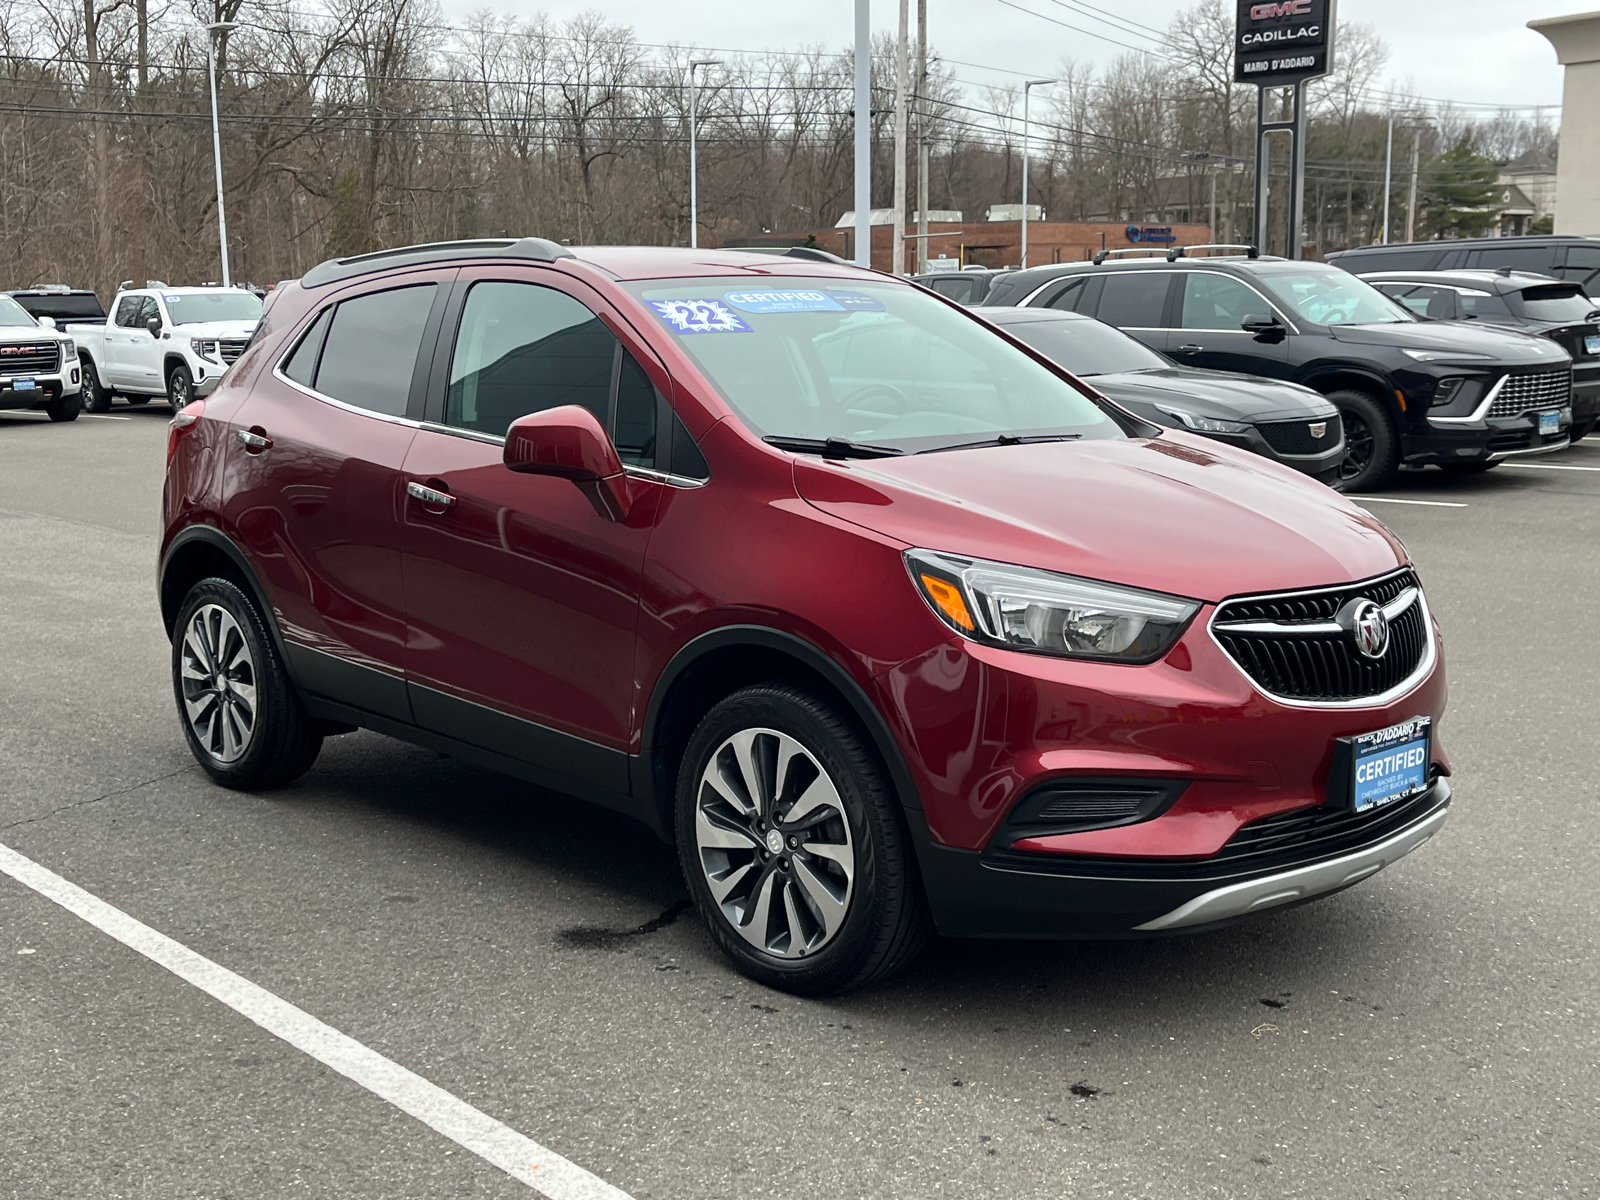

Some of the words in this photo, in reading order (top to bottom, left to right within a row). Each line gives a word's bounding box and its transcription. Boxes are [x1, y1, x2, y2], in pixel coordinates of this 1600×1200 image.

[1250, 0, 1311, 19] GMC
[1241, 26, 1319, 44] CADILLAC
[1243, 60, 1269, 73] MARIO
[1271, 56, 1315, 70] D'ADDARIO
[728, 292, 825, 303] CERTIFIED
[675, 305, 725, 325] 22
[0, 346, 37, 356] GMC
[1377, 723, 1414, 743] D'ADDARIO
[1356, 747, 1425, 783] CERTIFIED
[1377, 775, 1397, 786] BACKED
[1397, 773, 1404, 781] BY
[1361, 785, 1389, 799] CHEVROLET
[1389, 780, 1404, 790] BUICK
[1402, 789, 1410, 798] CT
